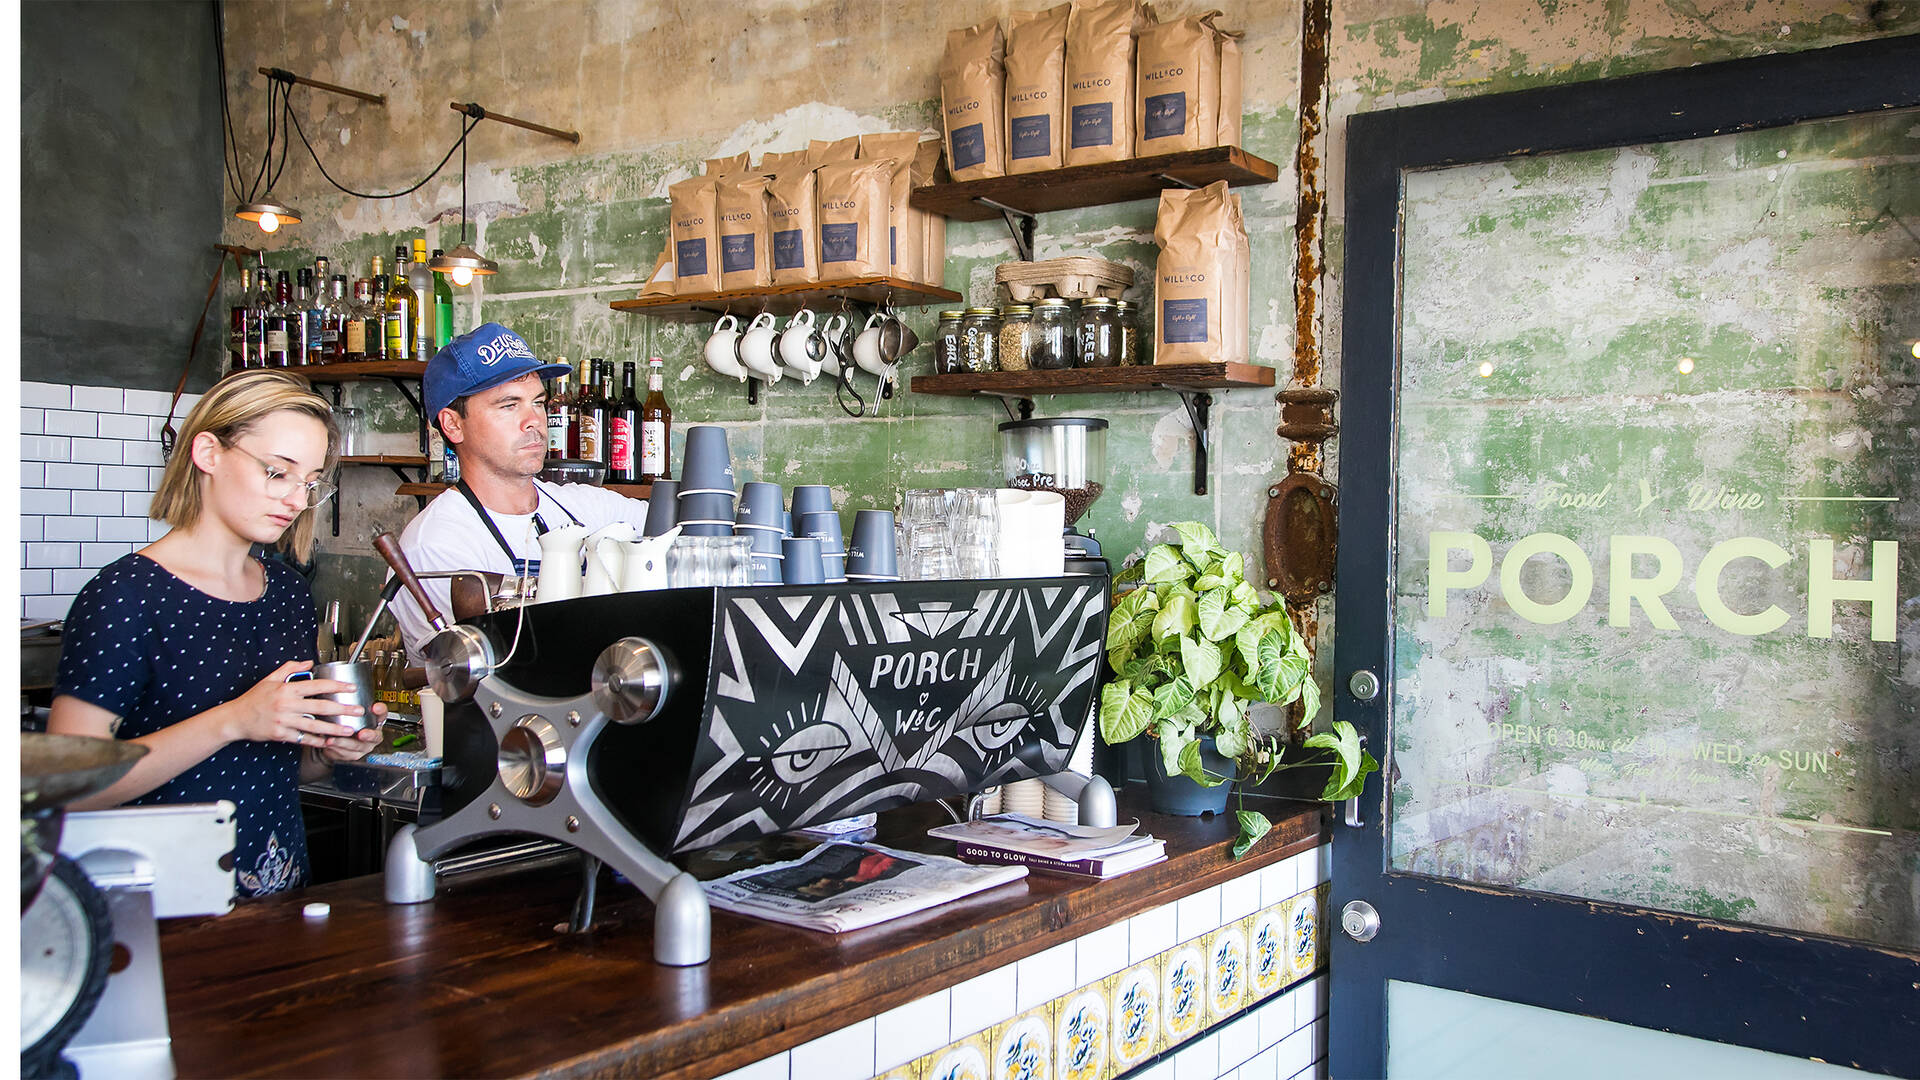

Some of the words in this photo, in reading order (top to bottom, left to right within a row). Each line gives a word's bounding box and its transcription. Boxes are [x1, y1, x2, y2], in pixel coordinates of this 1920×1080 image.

[945, 334, 957, 373] EARL
[1084, 323, 1095, 363] FREE
[1033, 473, 1054, 488] Pre
[1535, 482, 1612, 511] Food
[1687, 483, 1764, 512] Wine
[1427, 531, 1899, 643] PORCH
[869, 648, 982, 690] PORCH
[1487, 722, 1541, 744] OPEN
[1692, 741, 1743, 764] WED
[1778, 749, 1828, 773] SUN
[966, 847, 988, 857] GOOD
[991, 851, 1001, 859] TO
[1003, 853, 1027, 862] GLOW
